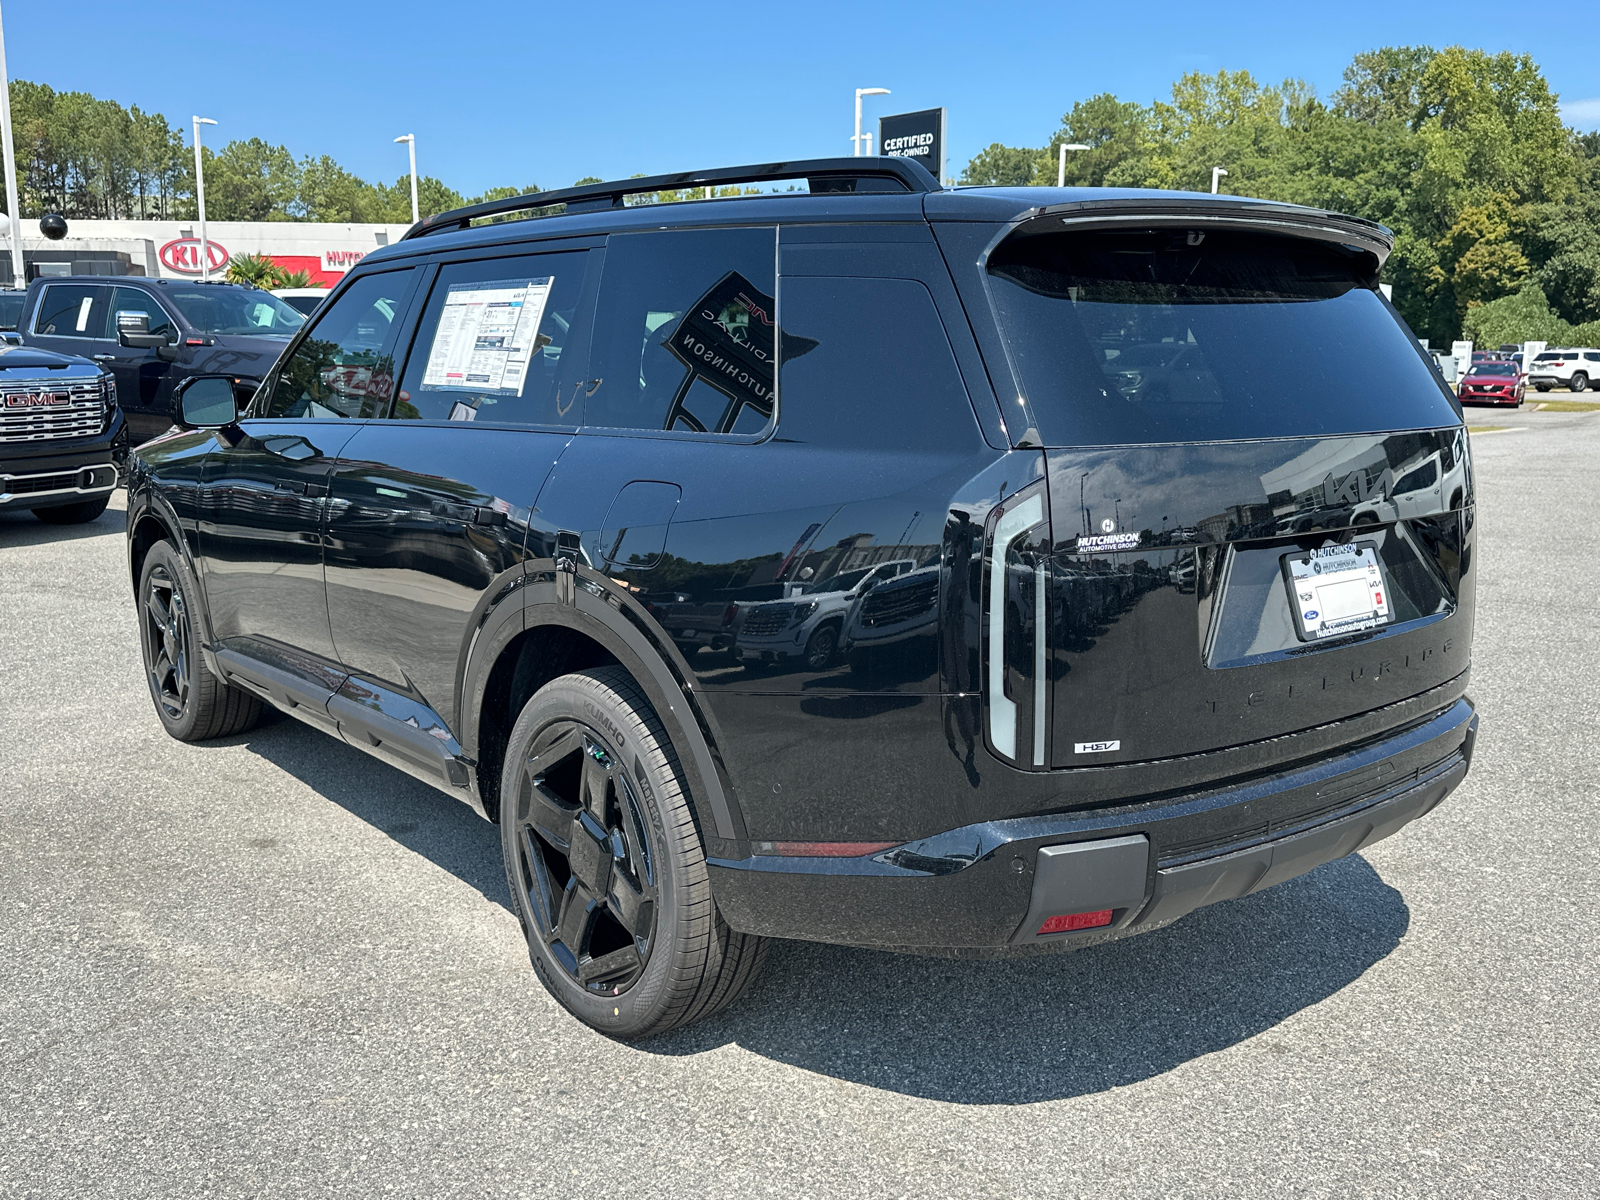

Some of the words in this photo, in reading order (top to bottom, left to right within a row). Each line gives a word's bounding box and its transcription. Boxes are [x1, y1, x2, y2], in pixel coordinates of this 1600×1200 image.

[884, 133, 934, 150] CERTIFIED
[888, 146, 929, 157] PRE-OWNED
[171, 245, 217, 266] KIA
[7, 391, 69, 407] GMC
[1323, 467, 1394, 506] KIA
[1077, 532, 1140, 547] HUTCHINSON
[1079, 543, 1117, 552] AUTOMOTIVE
[1117, 541, 1137, 549] GROUP
[1317, 543, 1357, 558] HUTCHINSON
[1316, 616, 1388, 638] Hutchinsonautogroup.com
[1206, 638, 1453, 714] TELLURIDE
[583, 700, 626, 748] KUMHO
[1083, 741, 1115, 751] HEV
